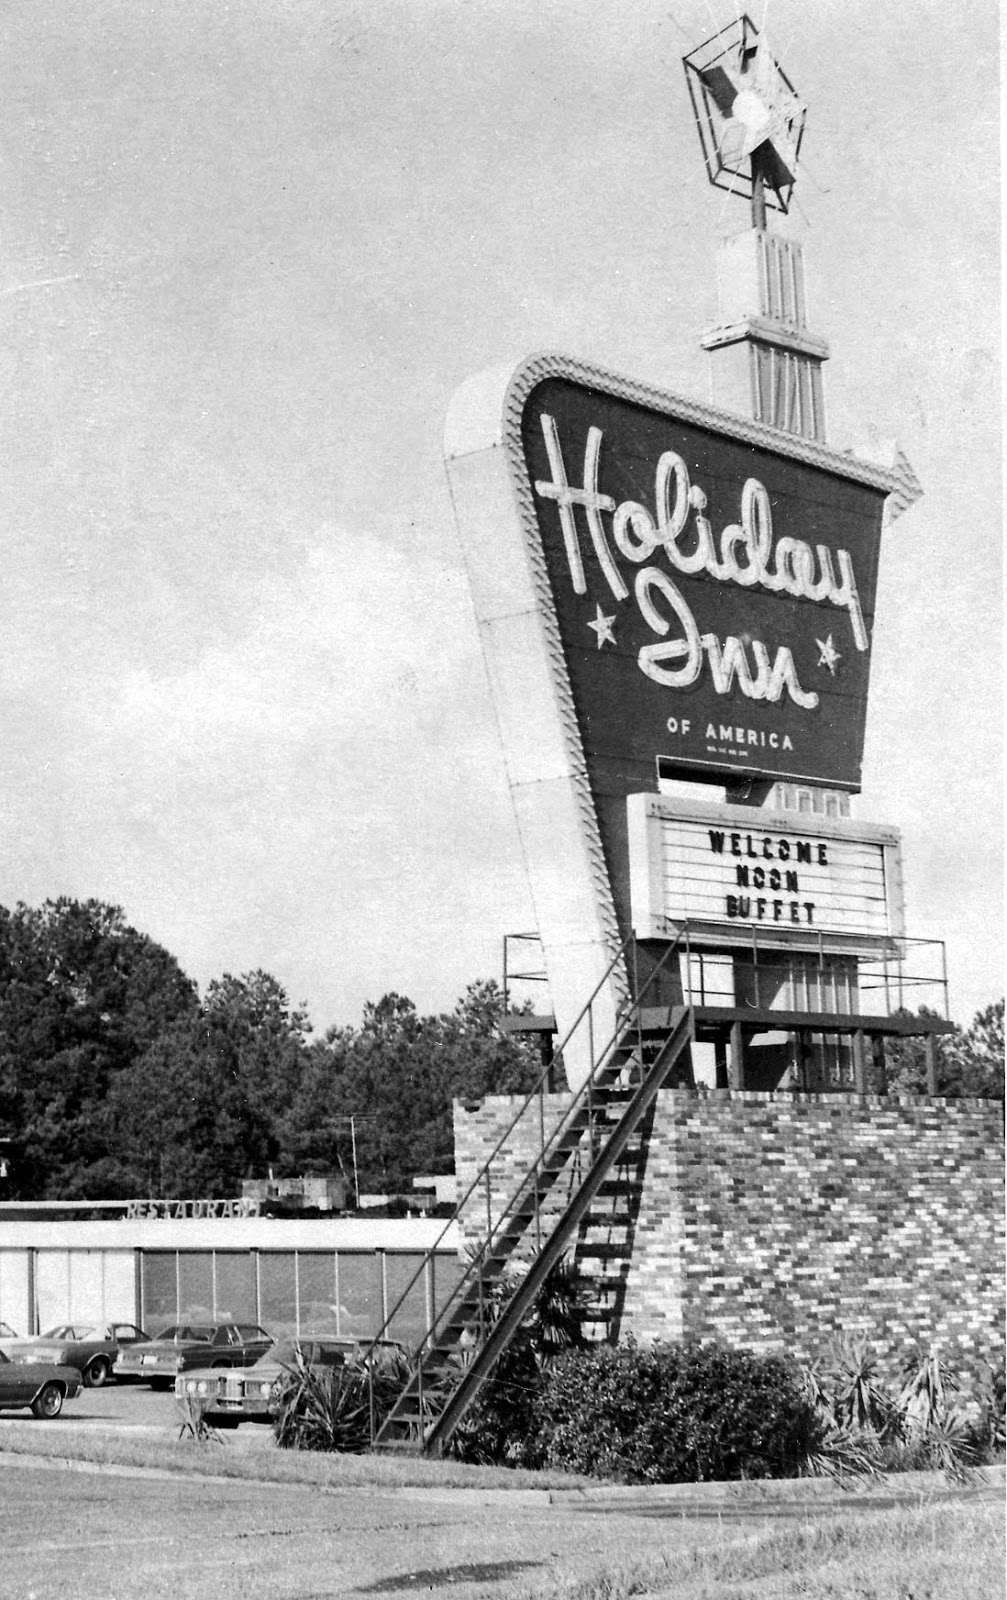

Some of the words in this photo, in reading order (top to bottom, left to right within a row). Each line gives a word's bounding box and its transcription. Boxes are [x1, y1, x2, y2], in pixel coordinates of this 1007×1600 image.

[534, 413, 868, 652] Holiday
[635, 567, 819, 709] Inn
[666, 716, 691, 735] OF
[705, 722, 794, 751] AMERICA
[708, 829, 829, 866] WELCOME
[736, 864, 799, 893] NOON
[726, 894, 815, 924] BUFFET
